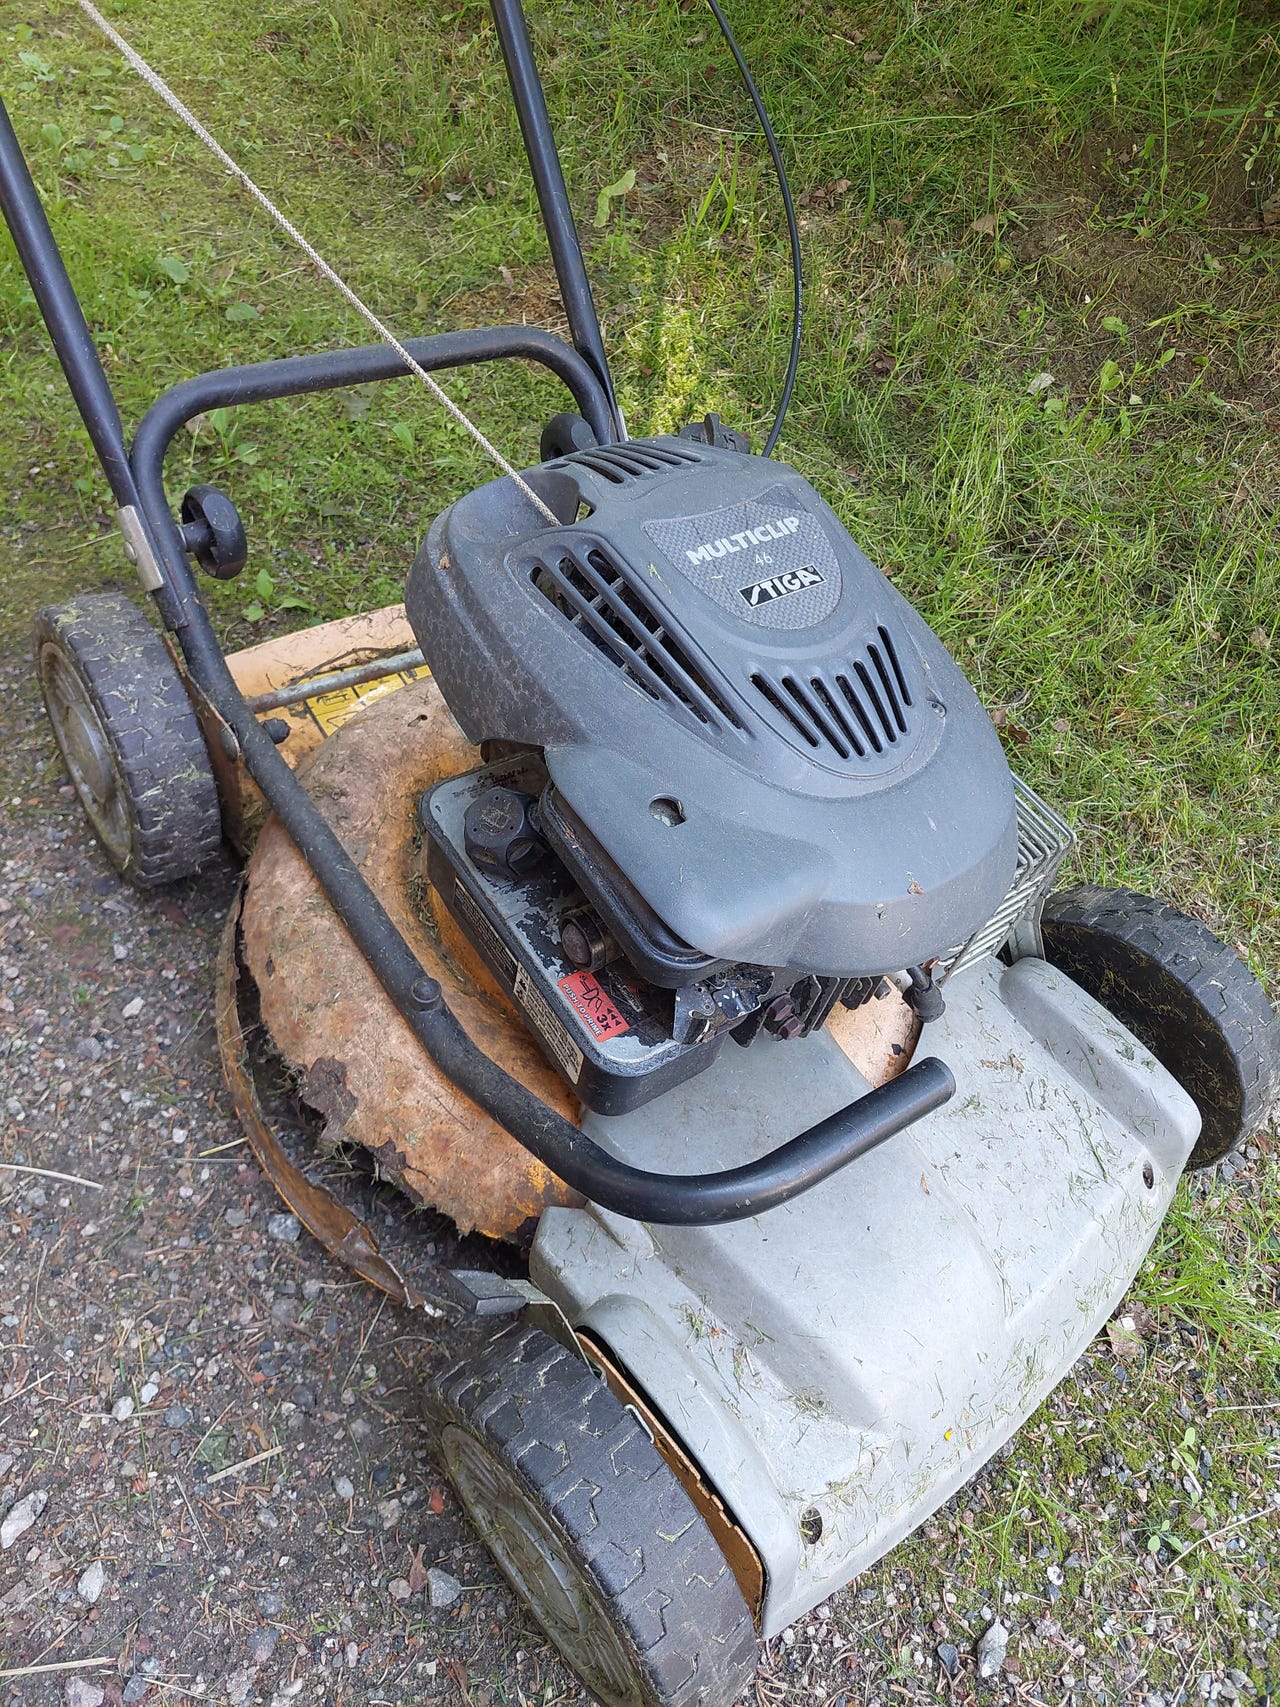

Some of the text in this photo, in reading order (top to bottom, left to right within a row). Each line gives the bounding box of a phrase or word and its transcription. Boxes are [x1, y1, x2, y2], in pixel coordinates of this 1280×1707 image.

[685, 516, 800, 565] MULTICLIP
[754, 551, 773, 566] 46
[749, 570, 821, 606] STIGA
[563, 983, 603, 1036] PUSH TO PRIME
